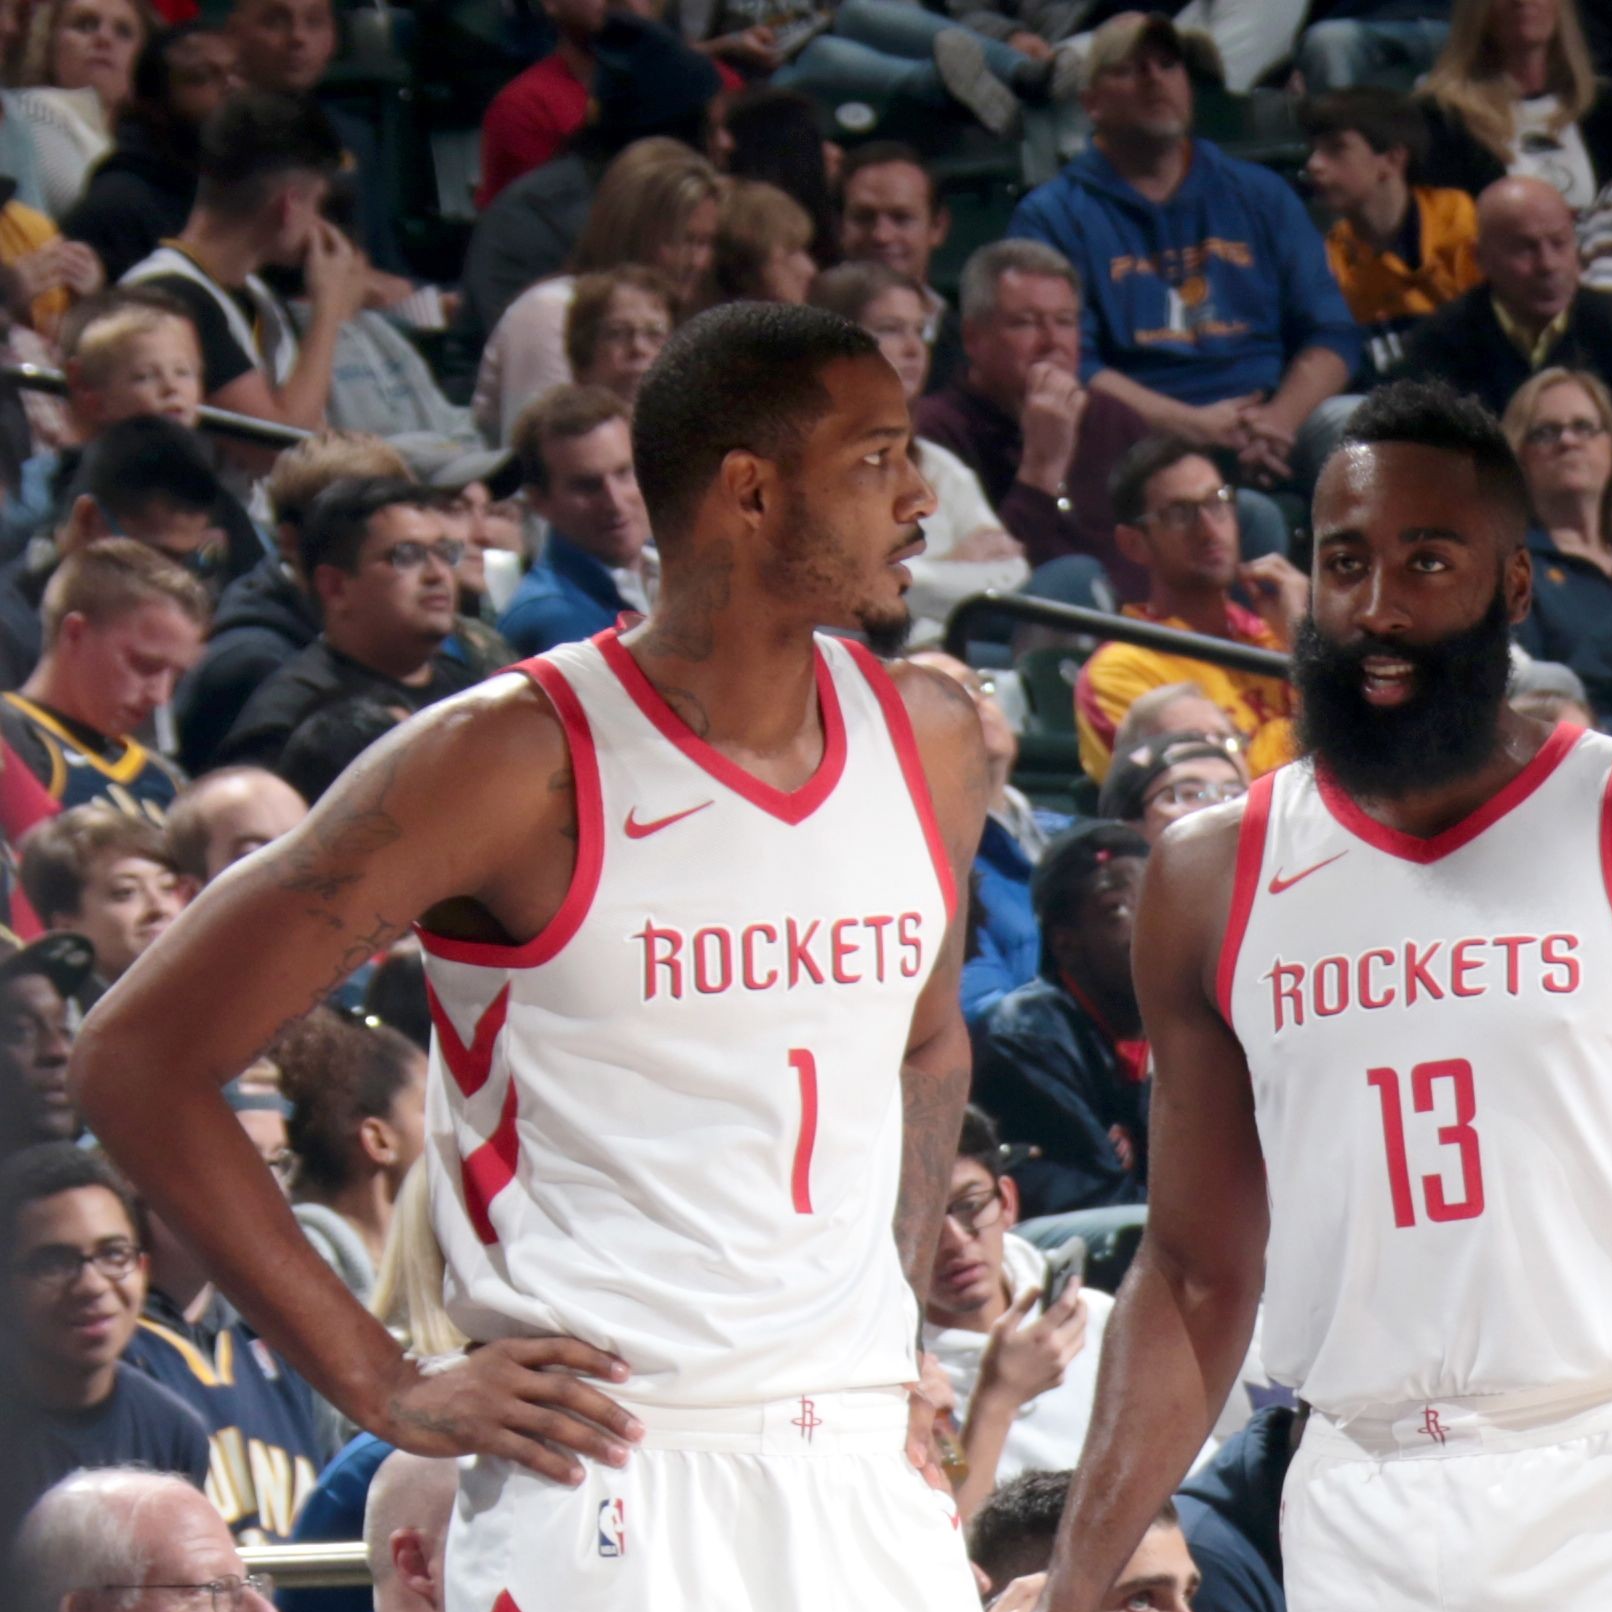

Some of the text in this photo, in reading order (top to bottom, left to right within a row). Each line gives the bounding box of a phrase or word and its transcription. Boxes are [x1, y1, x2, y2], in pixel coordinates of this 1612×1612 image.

[633, 910, 925, 1002] ROCKETS
[1260, 932, 1583, 1034] ROCKETS
[788, 1047, 820, 1214] 1
[1366, 1056, 1486, 1229] 13
